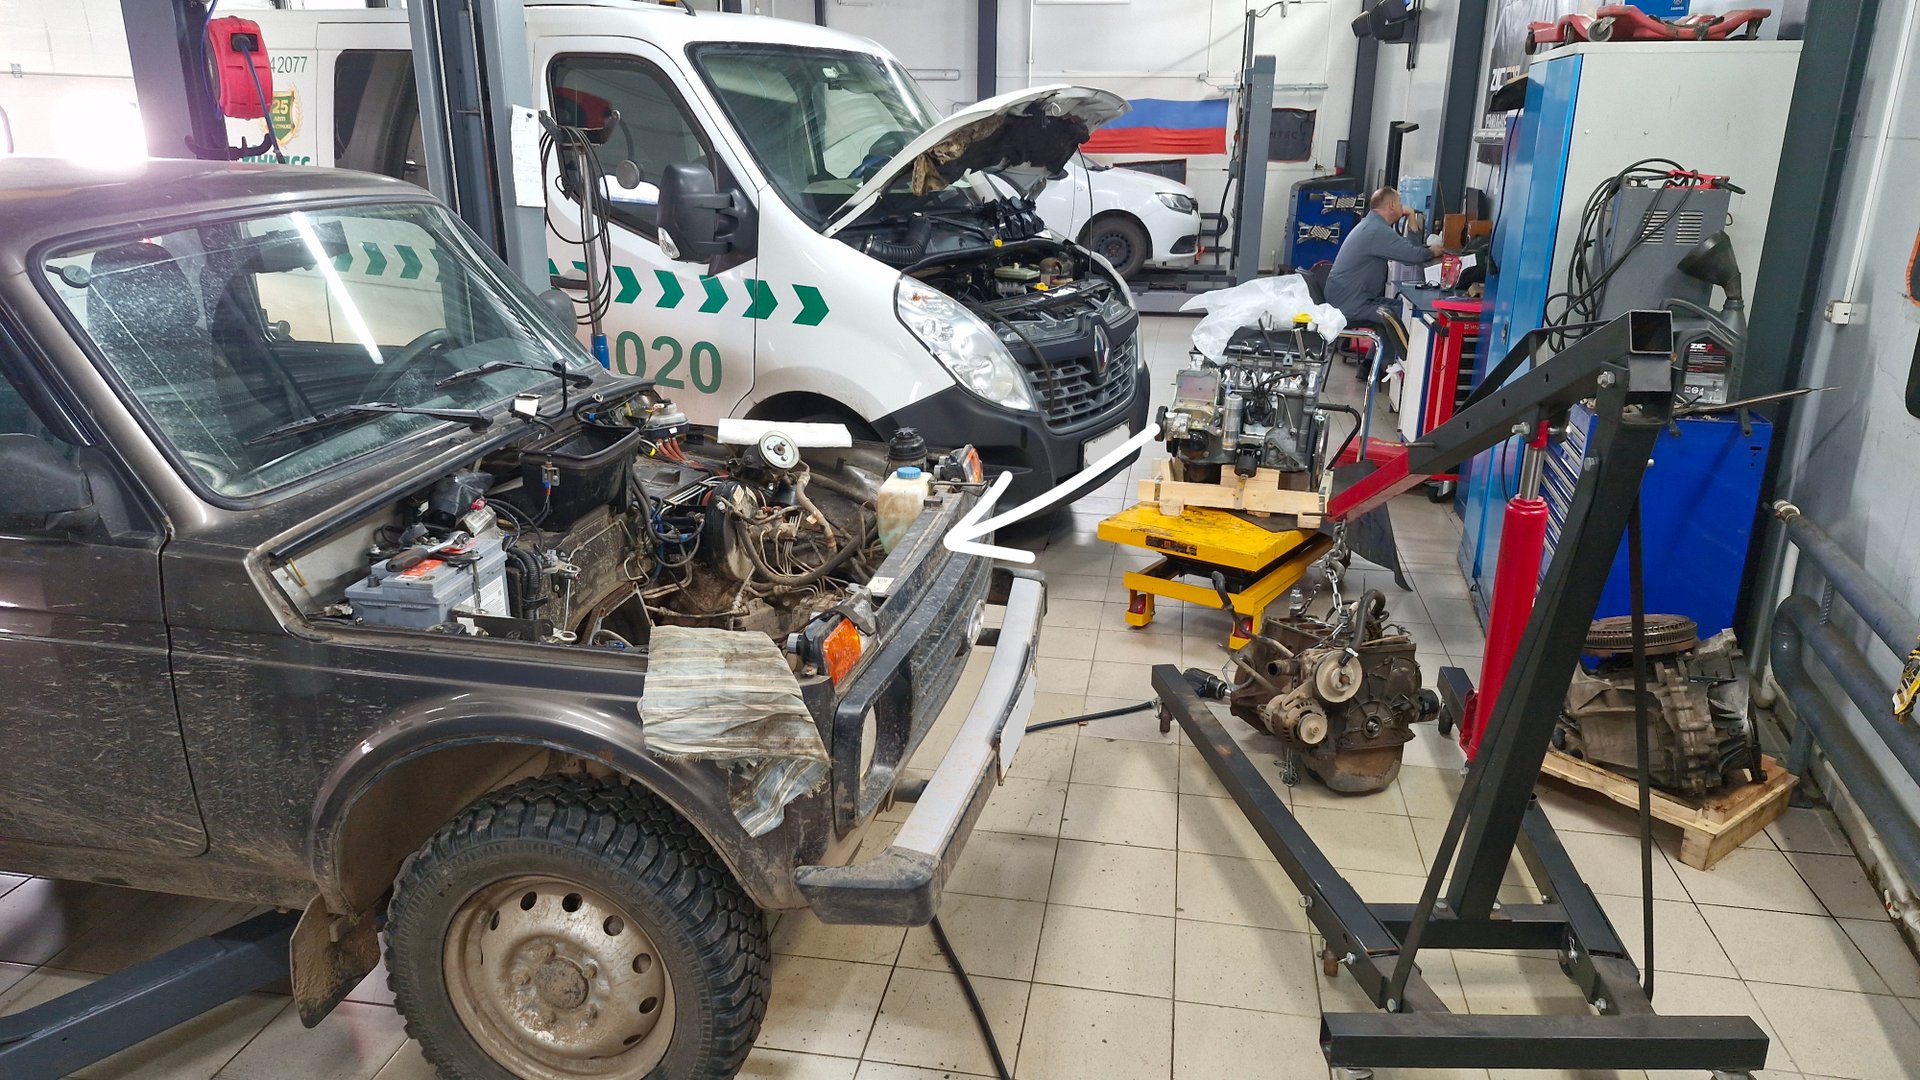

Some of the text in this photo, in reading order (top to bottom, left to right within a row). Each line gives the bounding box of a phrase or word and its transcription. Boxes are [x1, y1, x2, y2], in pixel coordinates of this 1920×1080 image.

[270, 56, 308, 73] 42077
[271, 99, 289, 115] 25
[616, 331, 722, 394] 020
